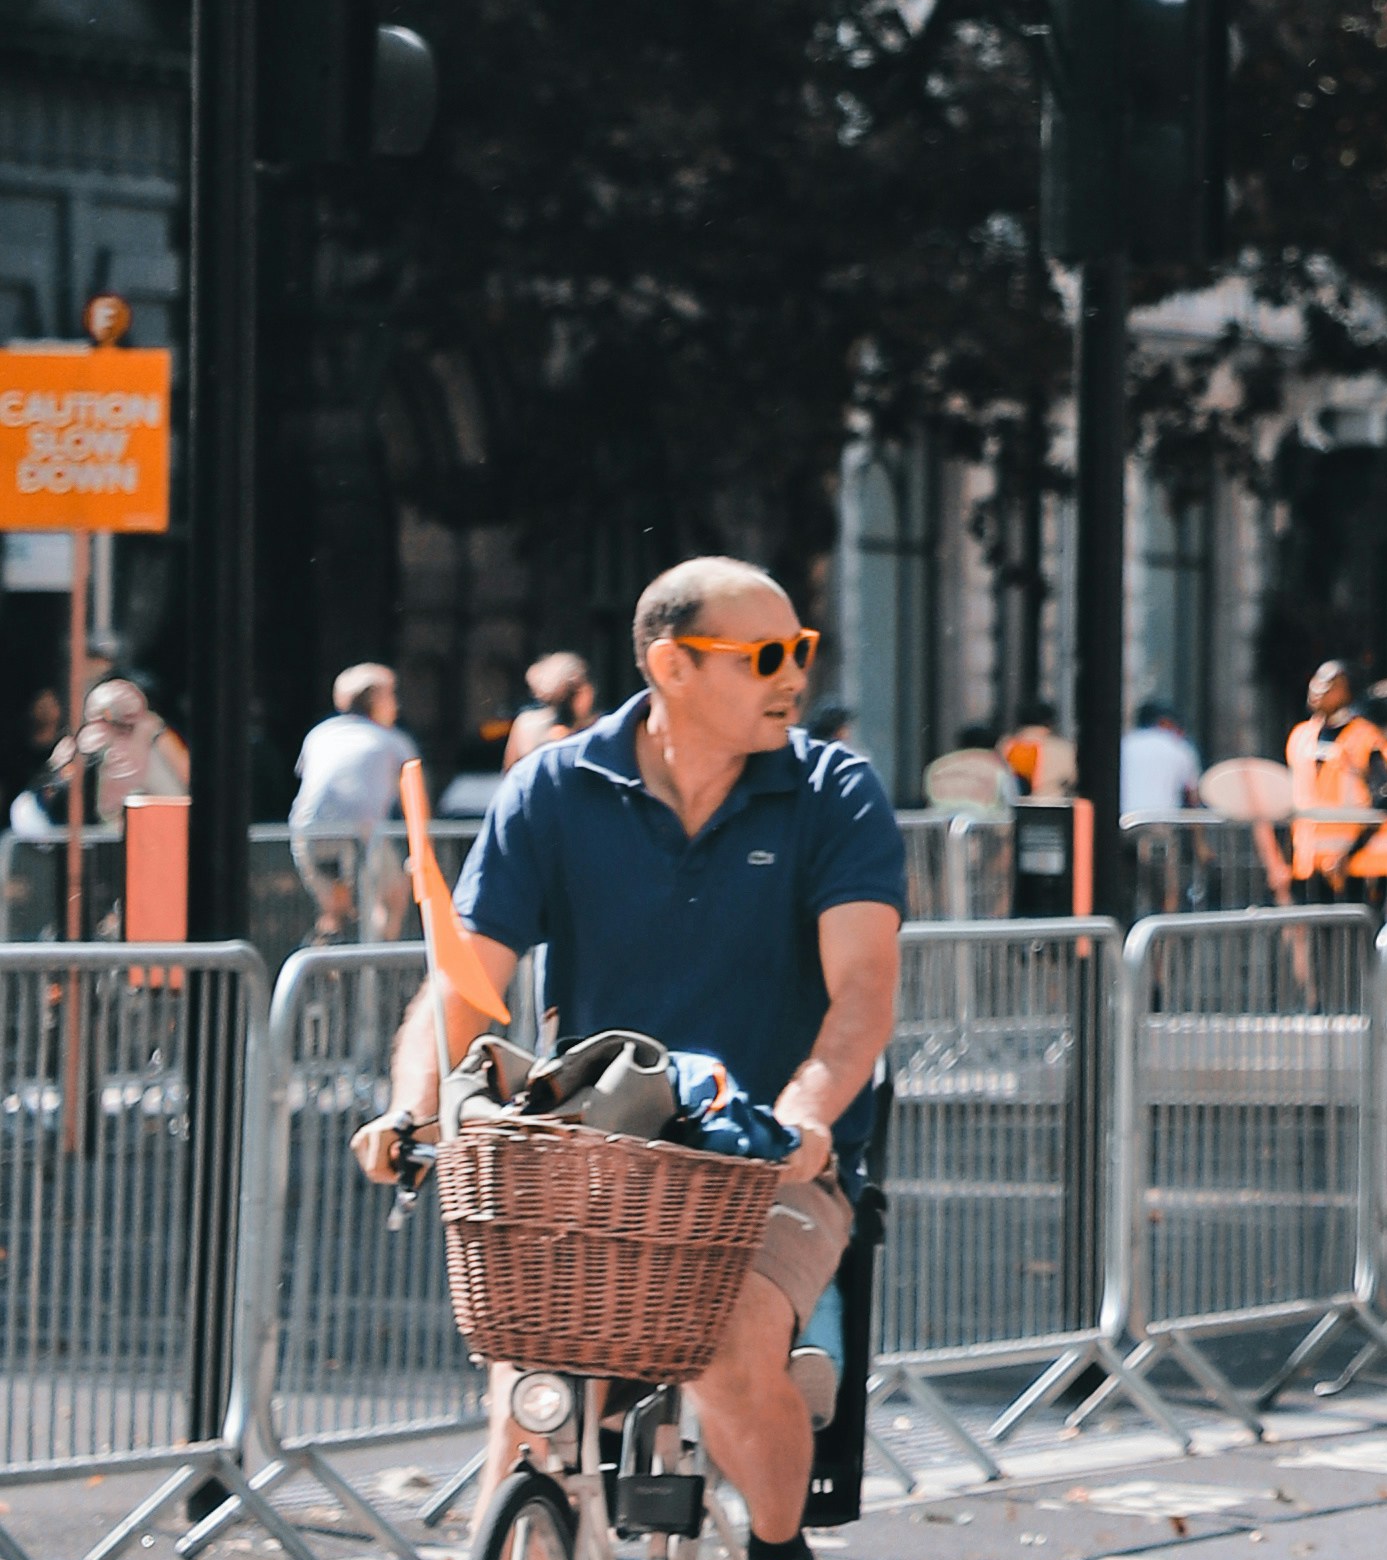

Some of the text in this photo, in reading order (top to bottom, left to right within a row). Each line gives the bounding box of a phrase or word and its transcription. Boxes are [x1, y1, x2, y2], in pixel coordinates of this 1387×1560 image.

[0, 390, 161, 428] CAUTION
[27, 428, 131, 462] SLOW
[17, 460, 139, 494] DOWN
